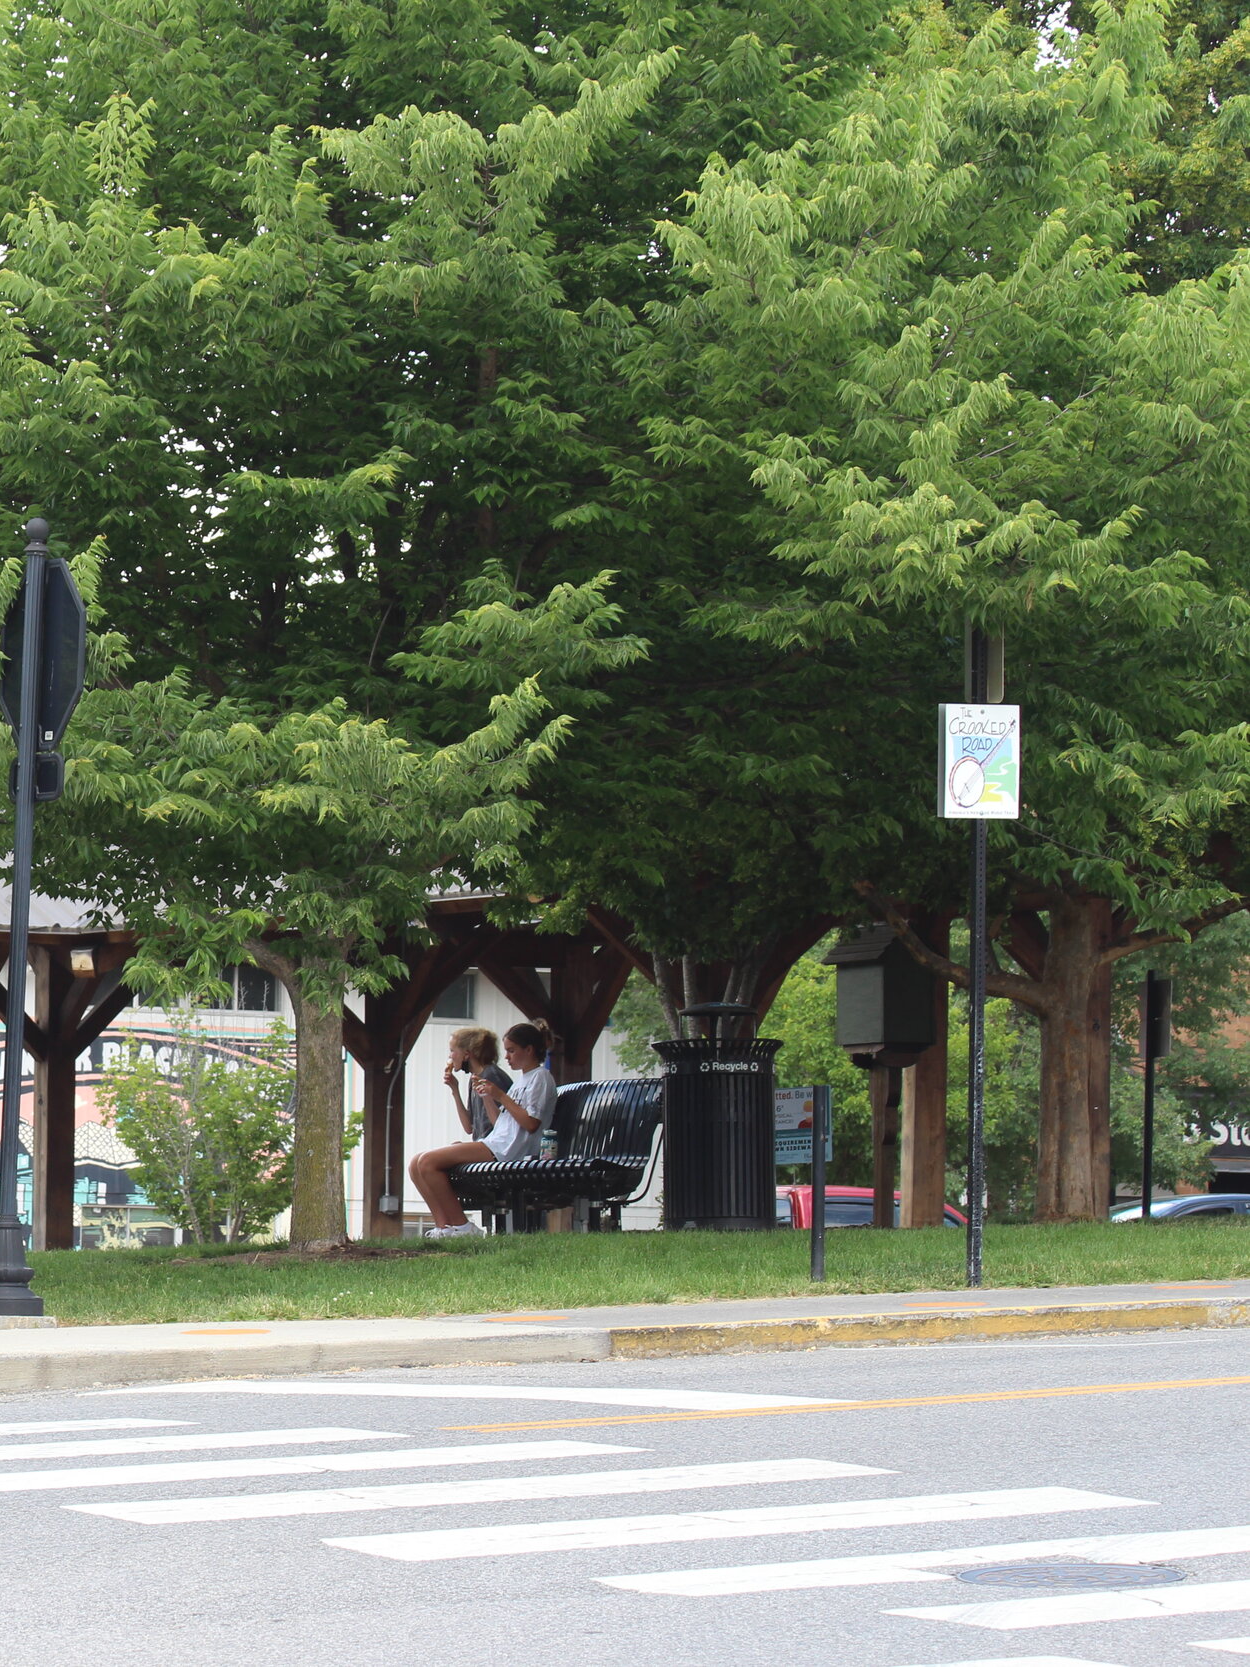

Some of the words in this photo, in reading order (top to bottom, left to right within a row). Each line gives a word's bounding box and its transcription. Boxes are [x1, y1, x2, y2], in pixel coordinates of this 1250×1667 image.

[949, 717, 1007, 735] CROOKED
[962, 736, 993, 755] ROAD
[712, 1062, 749, 1073] Recycle
